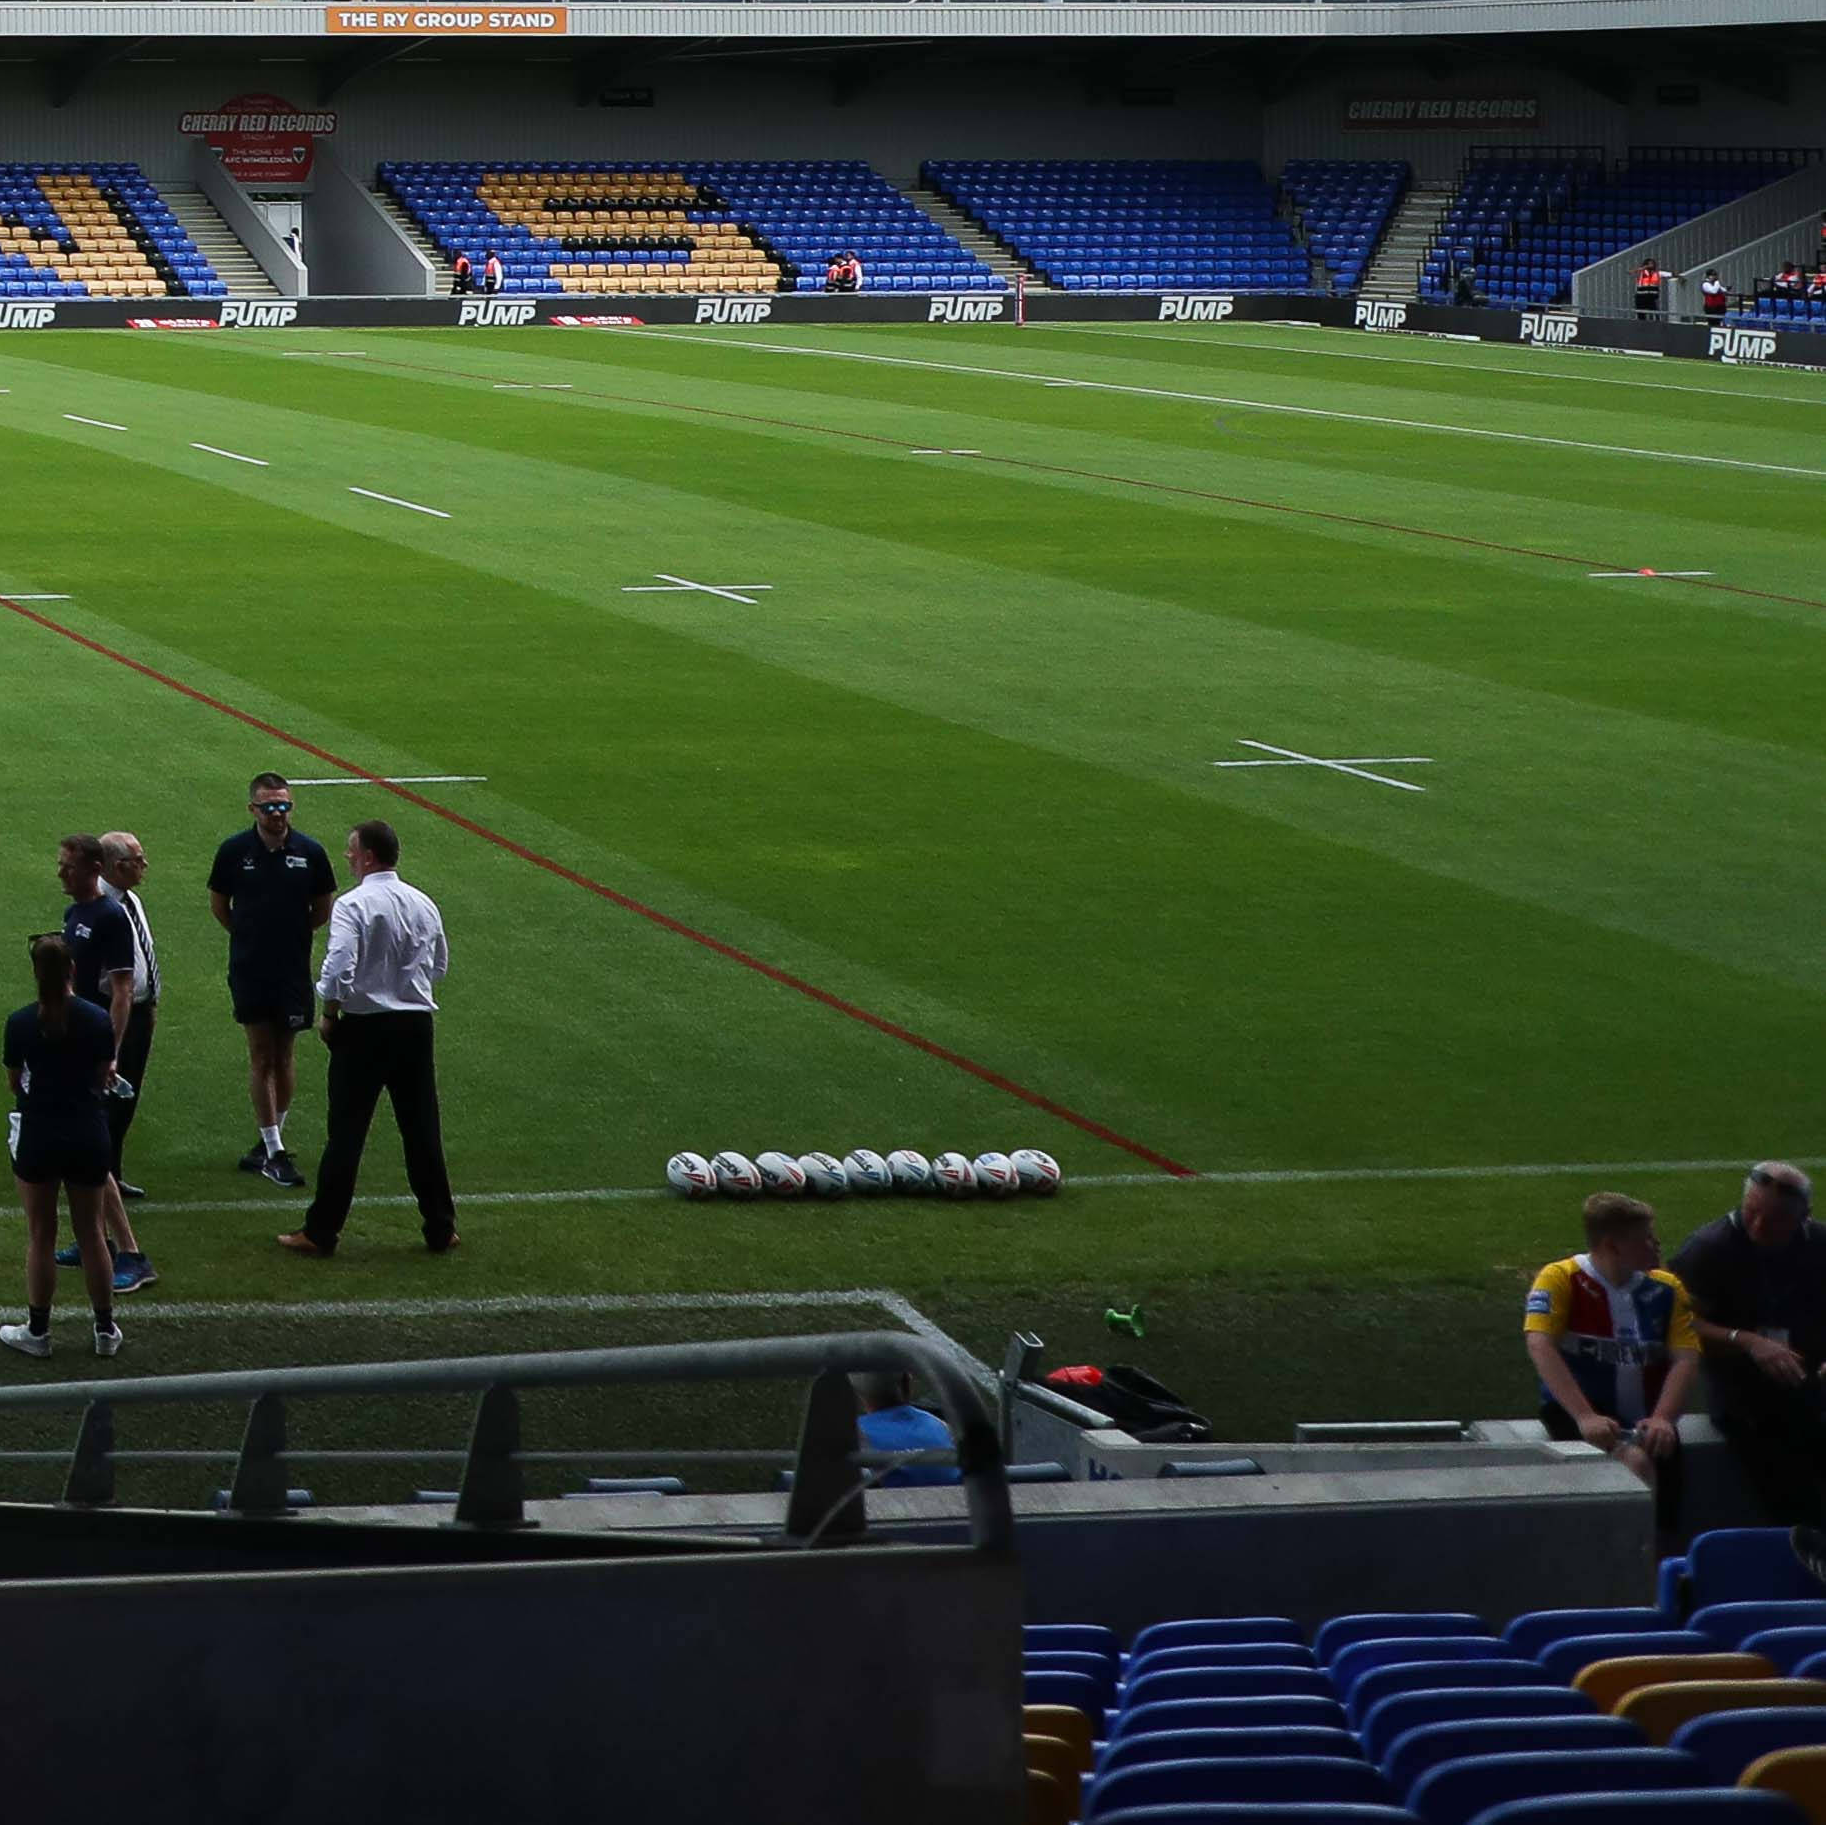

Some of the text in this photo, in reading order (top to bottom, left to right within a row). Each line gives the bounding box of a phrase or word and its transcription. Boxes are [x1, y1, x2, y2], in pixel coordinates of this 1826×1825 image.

[339, 13, 555, 28] THE RY GROUP STAND
[1349, 100, 1537, 119] CHERRY RED RECORDS
[181, 115, 335, 131] CHERRY RED RECORDS
[219, 302, 297, 327] PUMP
[458, 300, 536, 325] PUMP
[695, 298, 771, 323] PUMP
[928, 296, 1003, 321] PUMP
[1159, 296, 1233, 321] PUMP
[1355, 301, 1406, 328] PUMP
[1520, 314, 1578, 342] PUMP
[1709, 327, 1776, 359] PUMP
